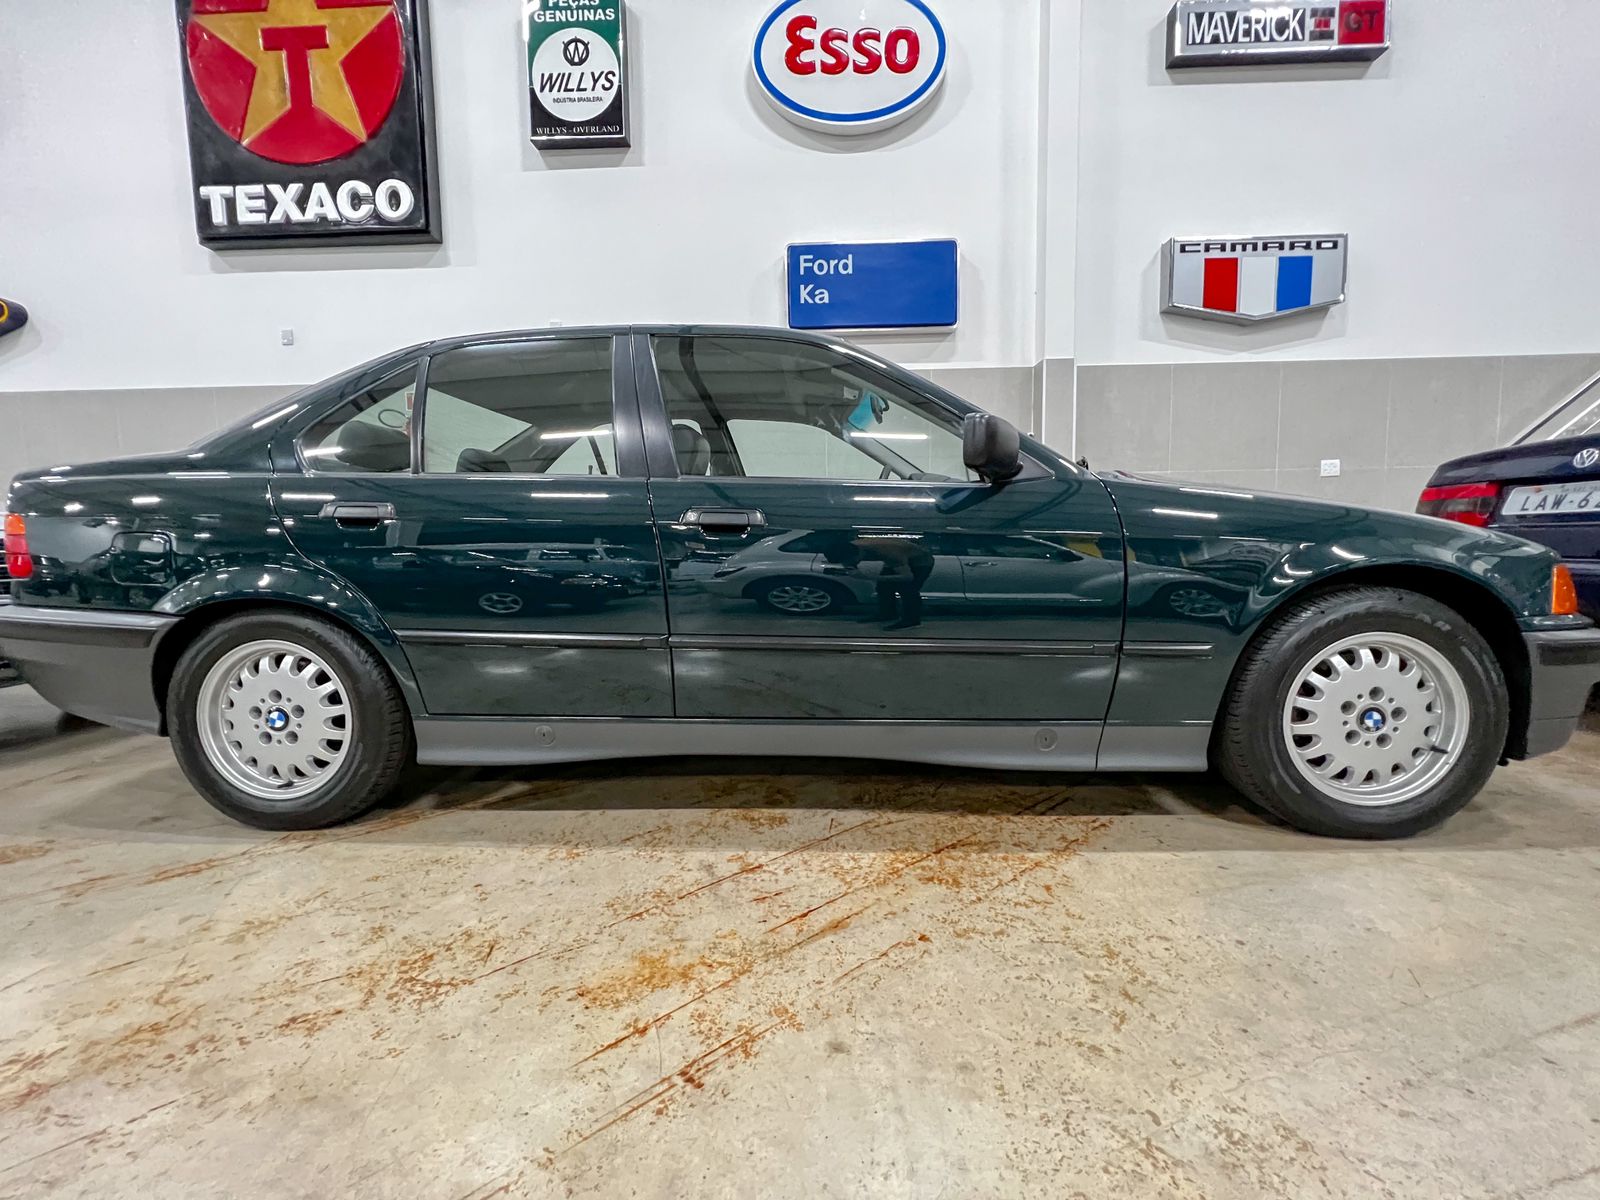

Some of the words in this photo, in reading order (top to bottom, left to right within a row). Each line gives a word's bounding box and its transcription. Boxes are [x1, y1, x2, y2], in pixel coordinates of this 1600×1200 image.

[1187, 8, 1305, 44] MAVERICK
[1343, 9, 1379, 33] GT
[260, 25, 329, 107] T
[539, 70, 616, 93] WILLYS
[536, 127, 567, 135] WILLYS
[573, 125, 620, 134] OVERLAND
[199, 178, 416, 227] TEXACO
[1179, 240, 1339, 253] CAMARO
[799, 254, 854, 275] Ford
[799, 284, 830, 304] Ka
